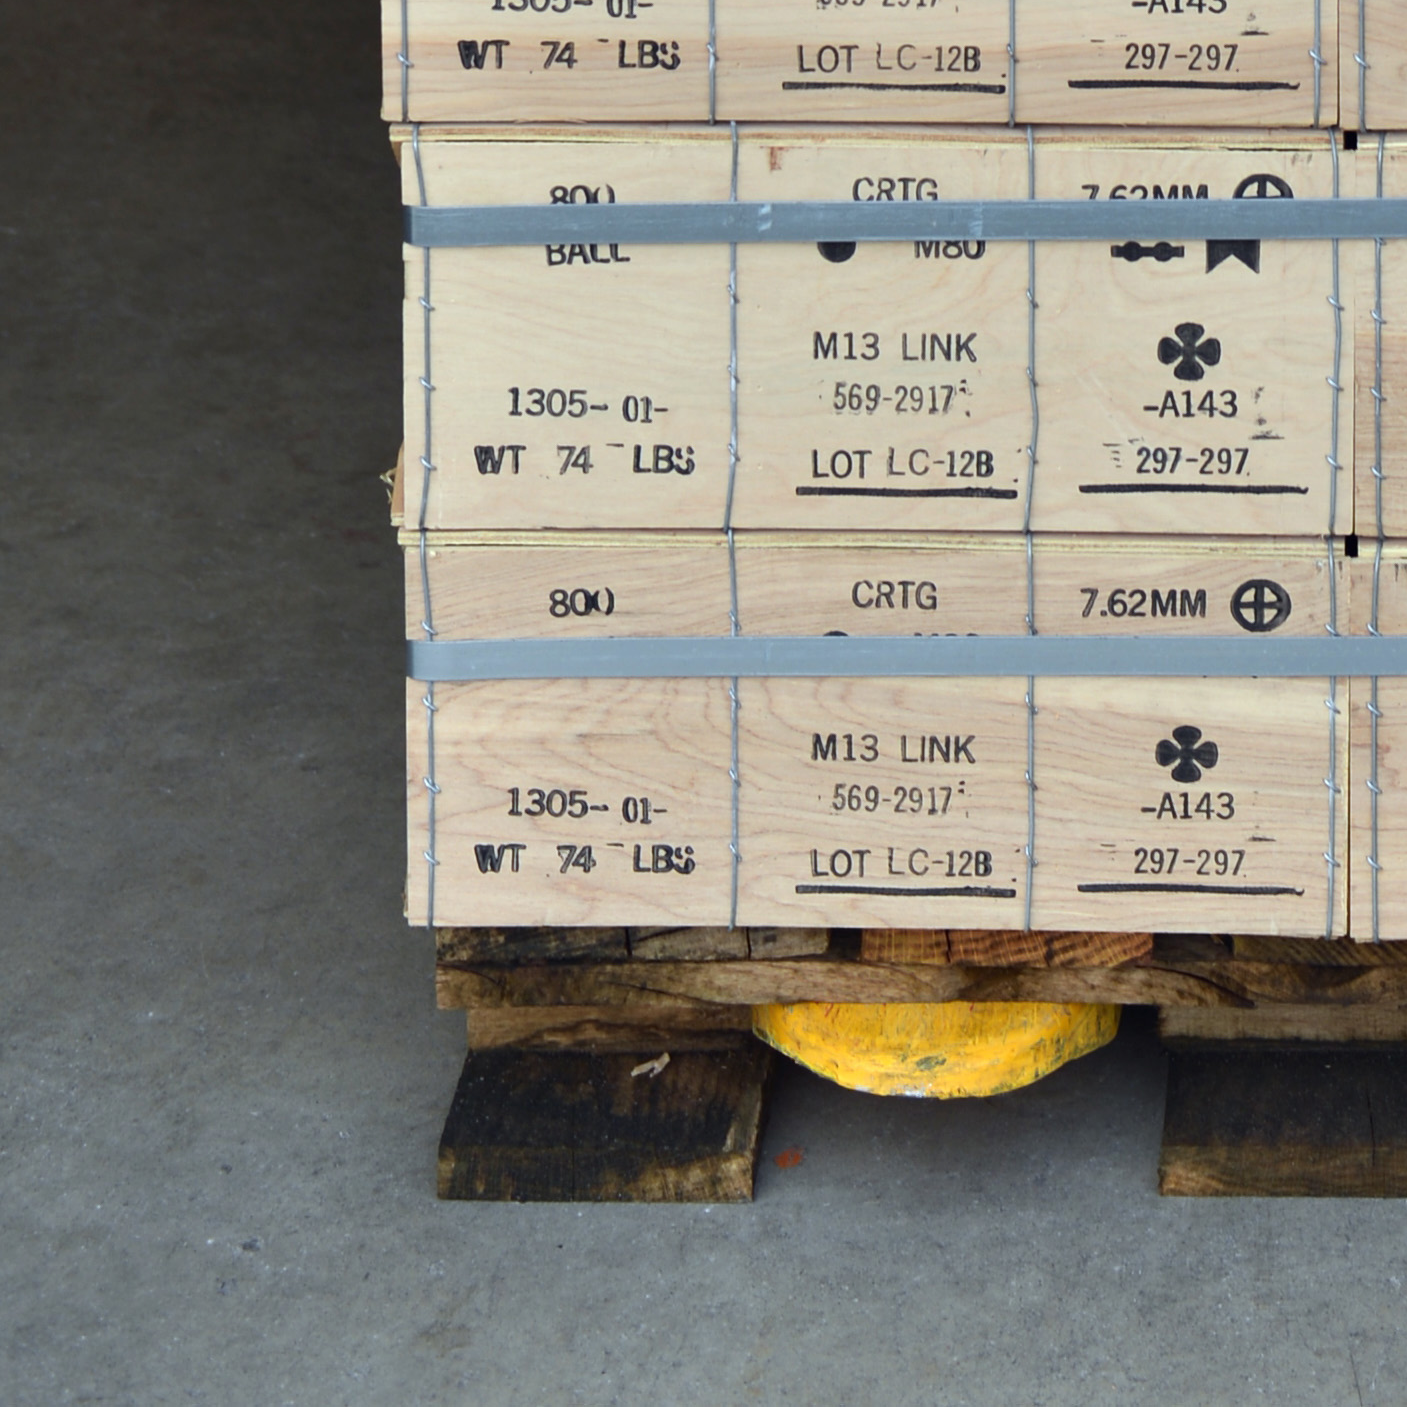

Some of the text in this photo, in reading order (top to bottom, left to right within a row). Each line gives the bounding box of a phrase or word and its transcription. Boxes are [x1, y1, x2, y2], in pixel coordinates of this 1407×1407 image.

[457, 40, 510, 70] WT
[541, 41, 578, 69] 74
[798, 43, 1238, 73] LOT LC-12B 297-297
[852, 178, 938, 204] CRTG
[545, 243, 629, 265] BALL
[814, 331, 977, 362] M13 LINK
[474, 445, 526, 475] WT
[557, 446, 593, 475] 74
[812, 447, 1249, 479] LOT LC-12B 297-297
[549, 580, 1206, 618] 800 CRTG 7.62MM
[812, 733, 975, 764] M13 LINK
[474, 844, 526, 874] WT
[557, 845, 596, 873] 74
[810, 847, 1245, 877] LOT LC-12B 297-297
